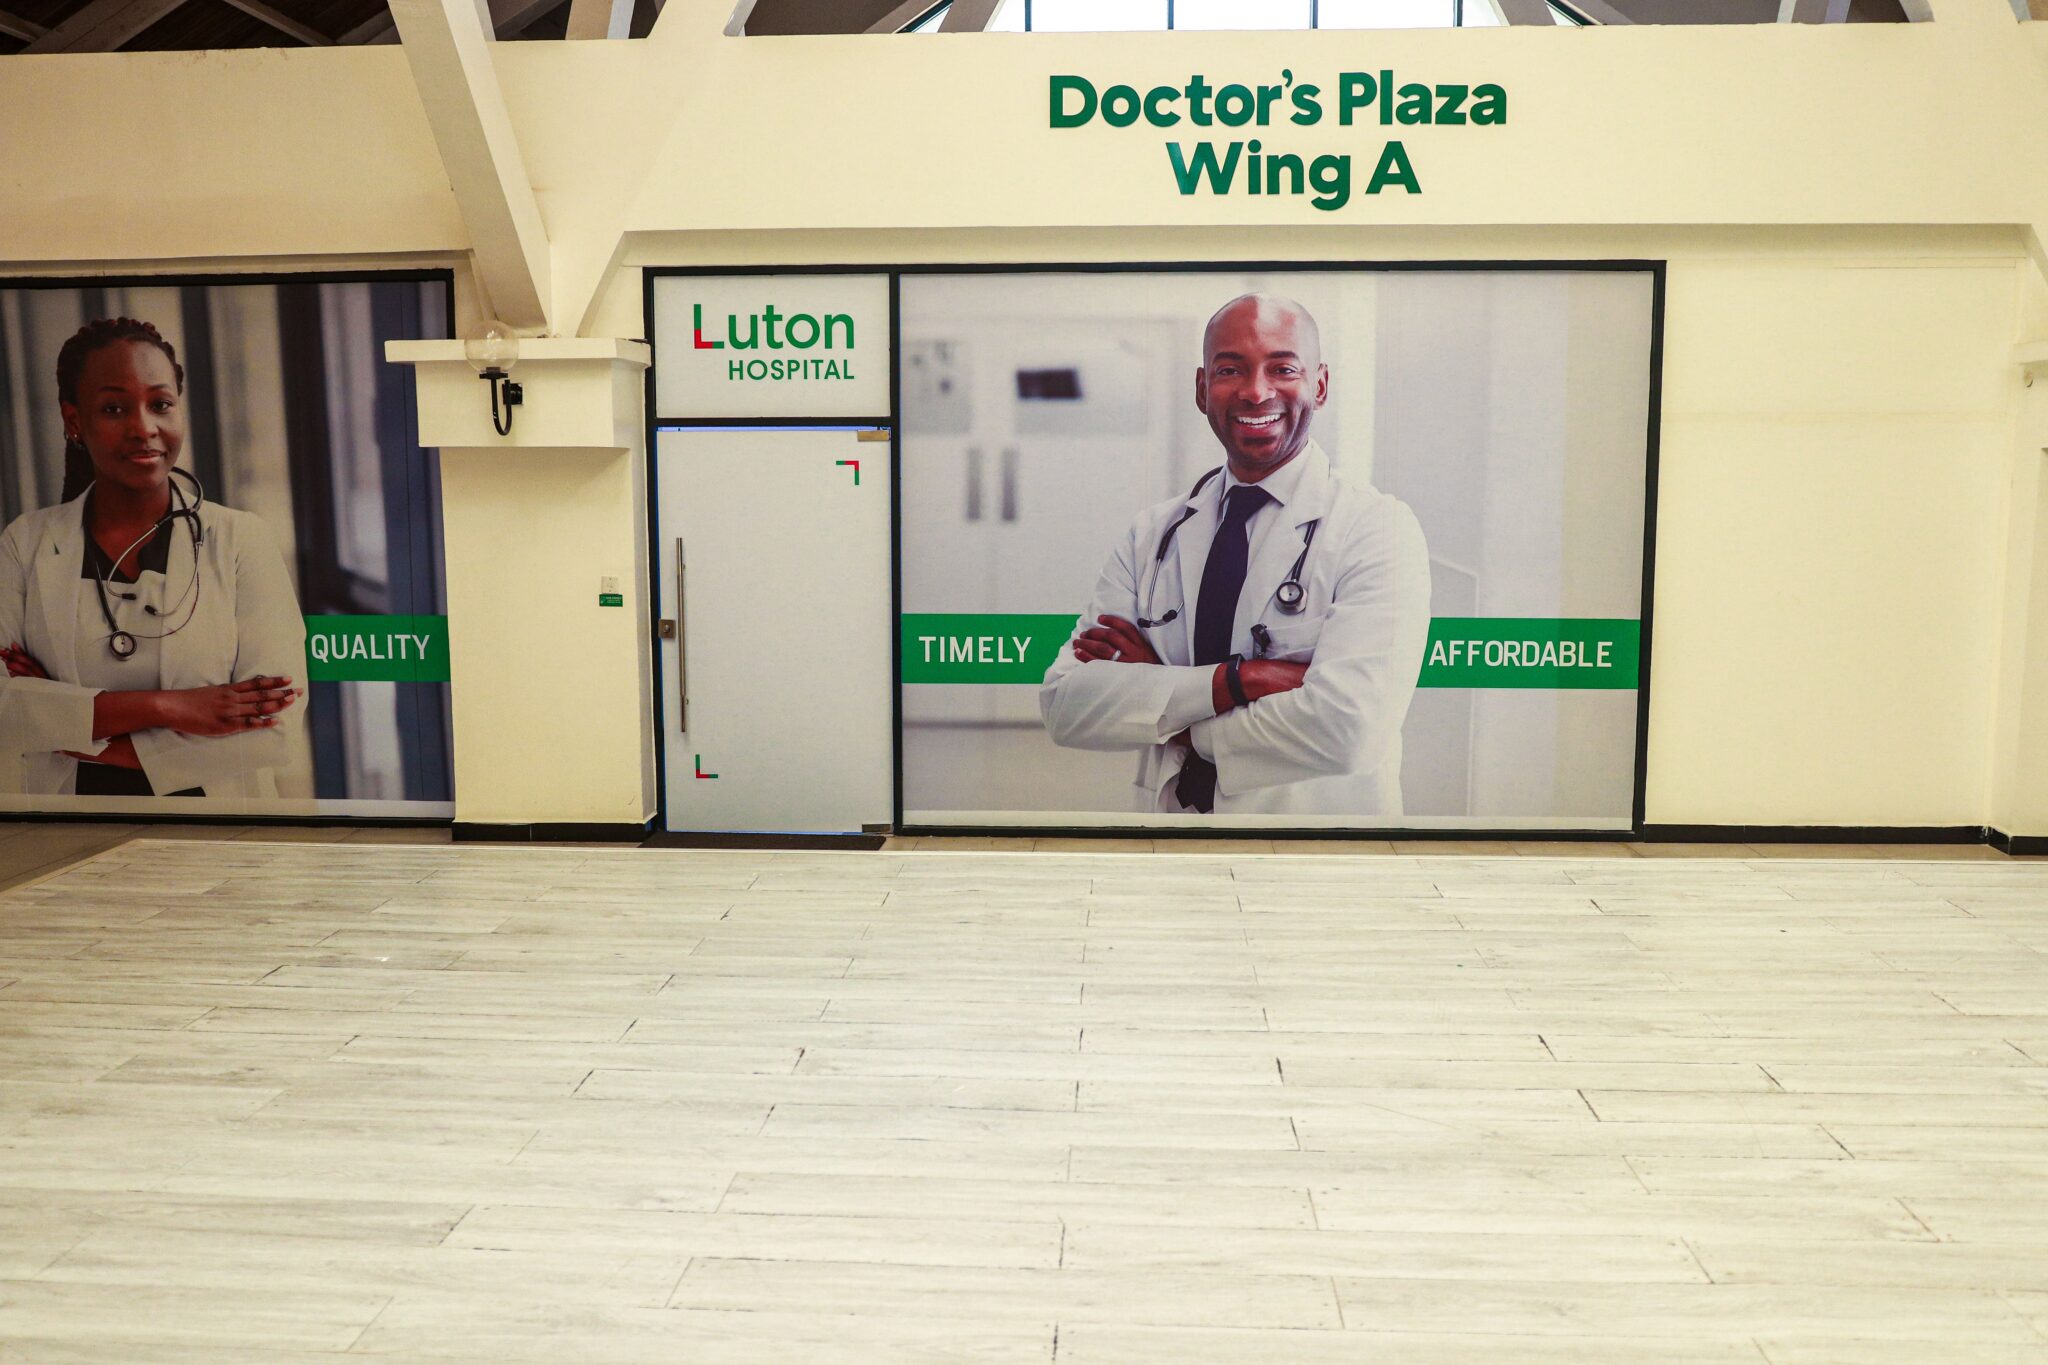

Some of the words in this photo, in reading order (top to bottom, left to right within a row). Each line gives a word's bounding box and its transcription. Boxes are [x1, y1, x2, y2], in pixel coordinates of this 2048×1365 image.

[1049, 69, 1323, 128] Doctor’s
[1338, 69, 1507, 126] Plaza
[1166, 139, 1351, 211] Wing
[1366, 140, 1422, 195] A
[693, 303, 855, 350] Luton
[728, 358, 855, 381] HOSPITAL
[311, 634, 430, 663] QUALITY
[918, 636, 1032, 663] TIMELY
[1428, 640, 1613, 667] AFFORDABLE
